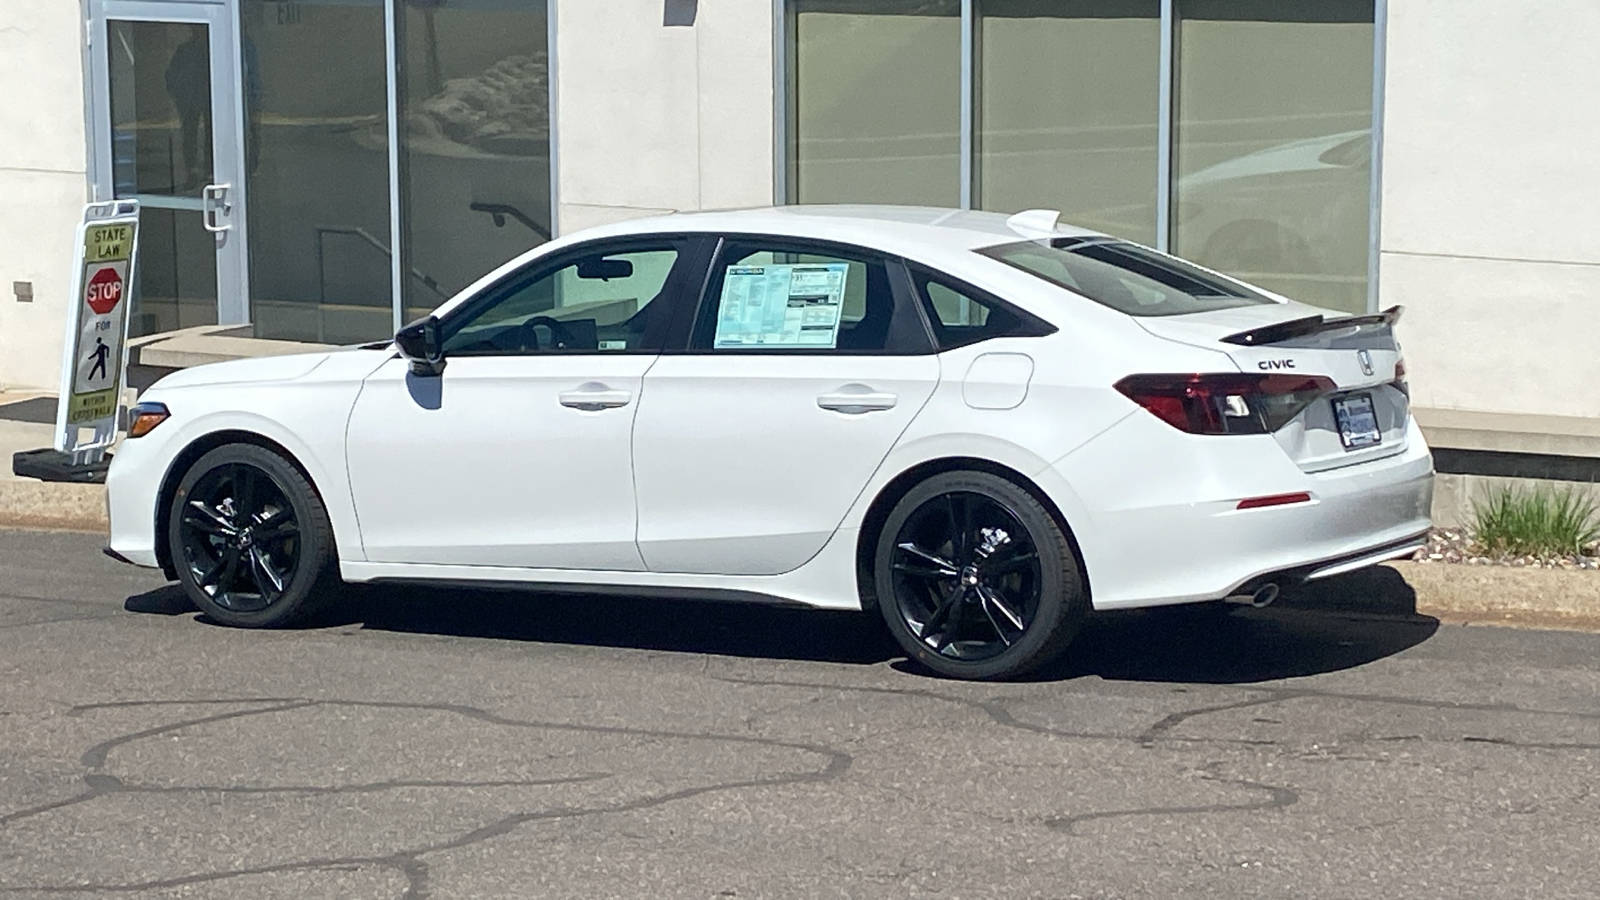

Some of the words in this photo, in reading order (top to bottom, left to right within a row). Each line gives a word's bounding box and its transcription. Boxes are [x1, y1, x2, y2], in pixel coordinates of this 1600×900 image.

[95, 228, 126, 243] STATE
[98, 244, 120, 258] LAW
[88, 281, 122, 302] STOP
[95, 320, 111, 332] FOR
[1258, 359, 1295, 370] CIVIC
